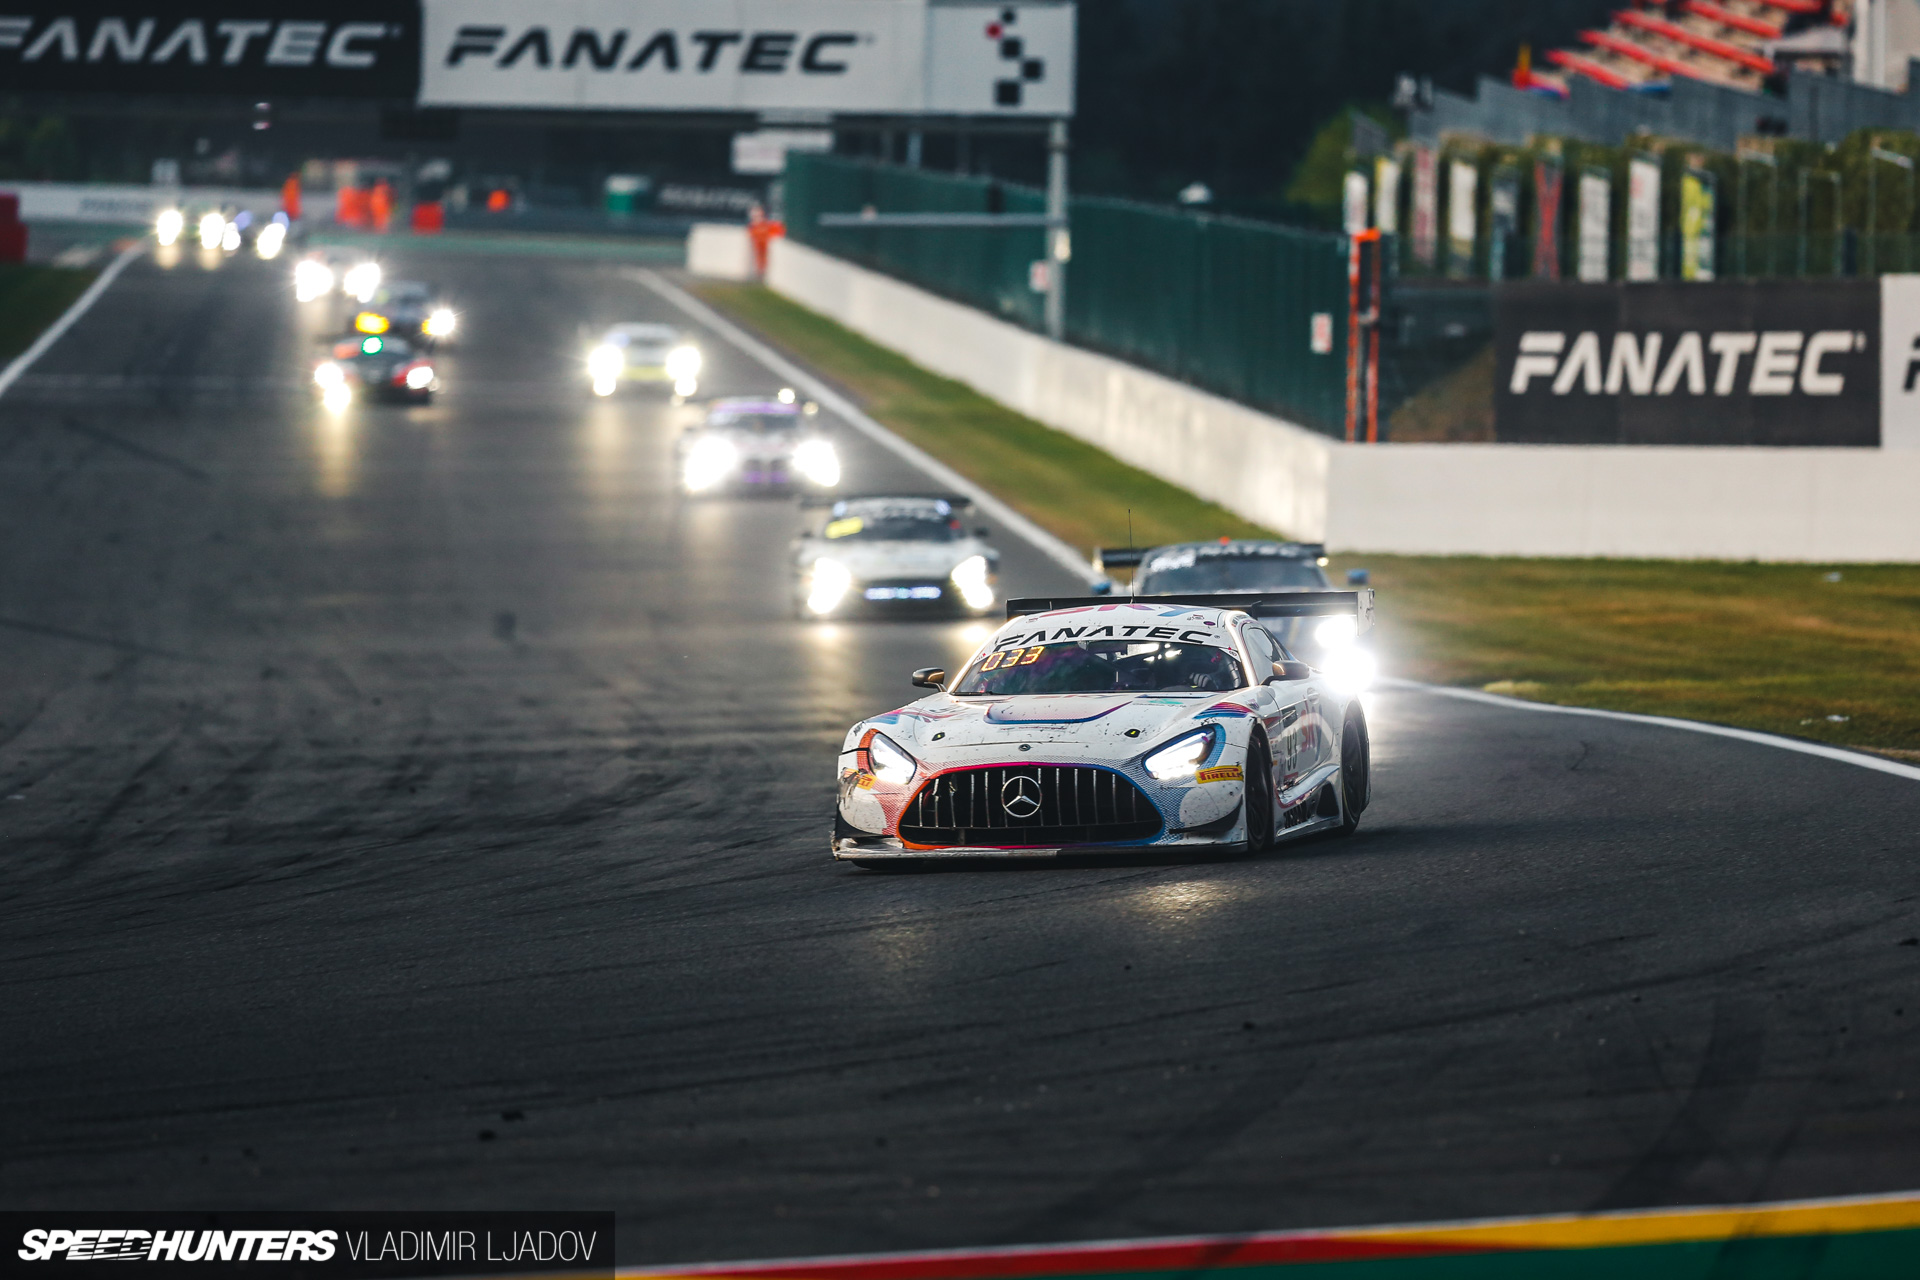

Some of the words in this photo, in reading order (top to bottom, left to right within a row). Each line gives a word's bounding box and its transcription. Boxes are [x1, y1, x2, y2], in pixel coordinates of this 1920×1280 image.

[445, 26, 860, 74] FANATEC
[1510, 331, 1854, 395] FANATEC
[994, 625, 1214, 652] FANATEC
[981, 646, 1044, 672] 033
